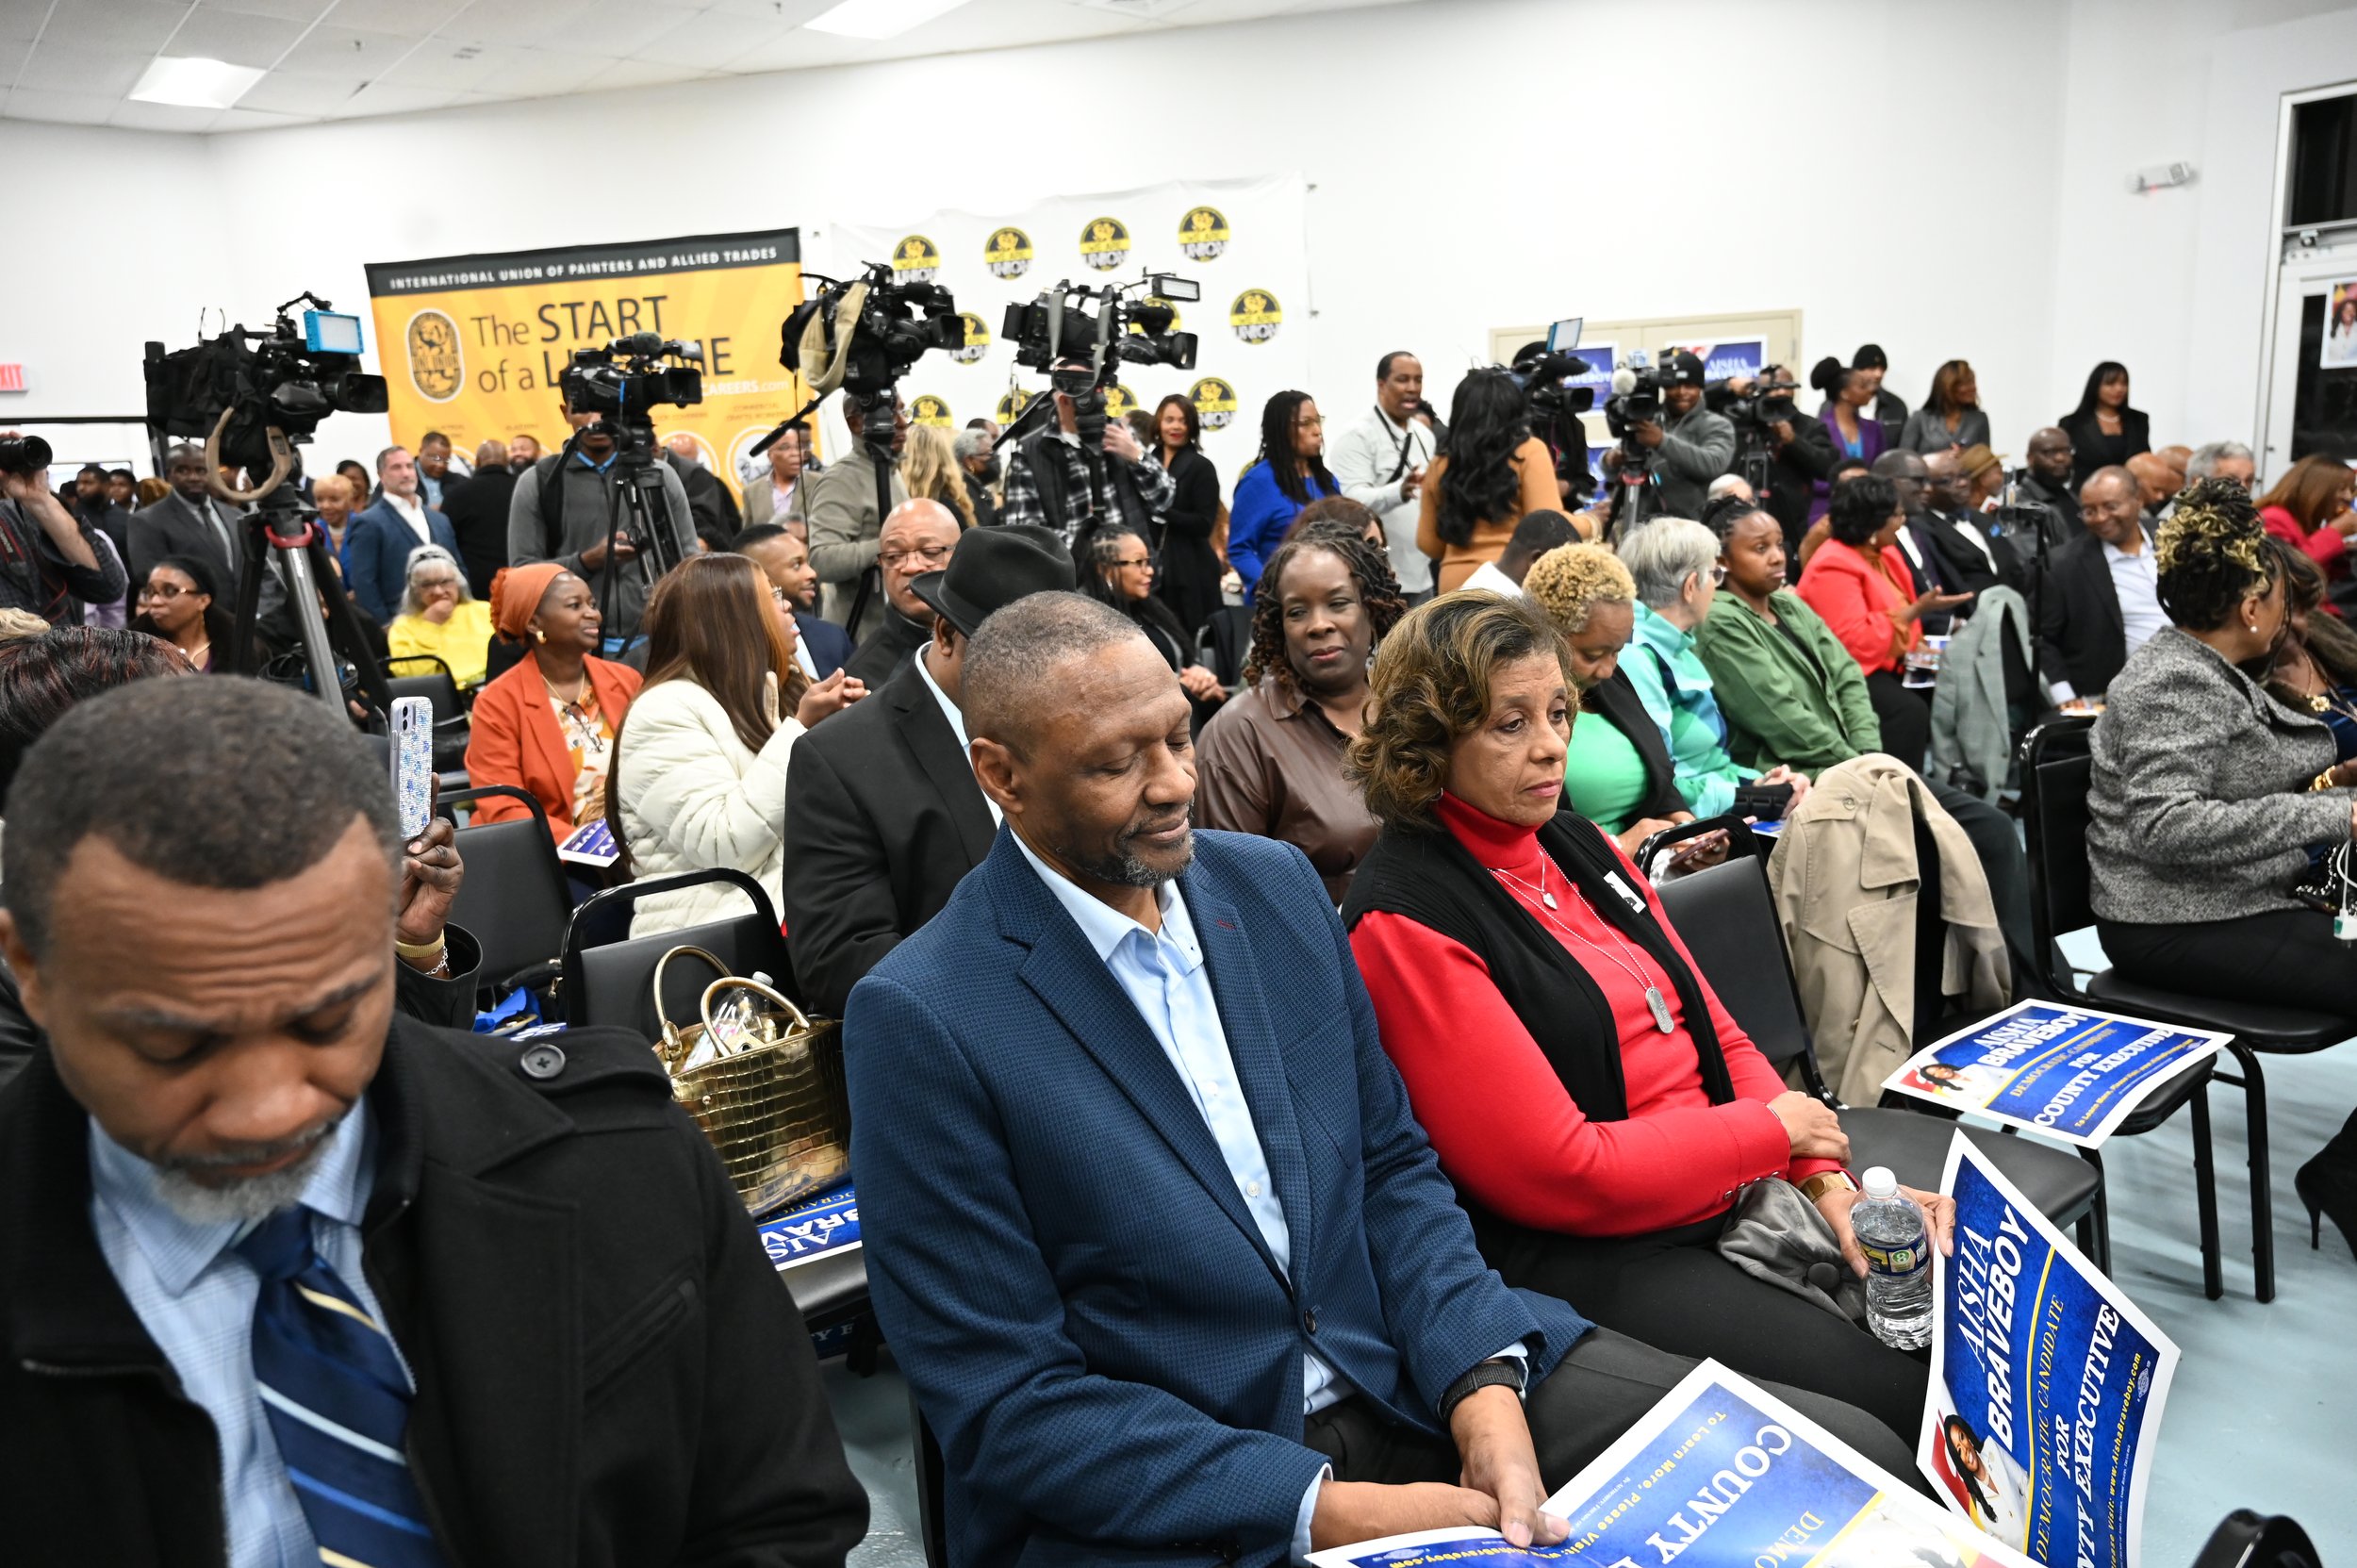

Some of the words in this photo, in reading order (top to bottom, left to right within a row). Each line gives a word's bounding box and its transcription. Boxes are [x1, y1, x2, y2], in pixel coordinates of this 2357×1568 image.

[389, 271, 495, 289] INTERNATIONAL
[499, 267, 542, 281] UNION
[546, 264, 564, 277] OF
[569, 257, 634, 276] PAINTERS
[637, 256, 667, 271] AND
[670, 251, 719, 268] ALLIED
[723, 246, 777, 263] TRADES
[470, 314, 530, 348] The
[537, 295, 668, 342] START
[478, 358, 508, 393] of
[519, 368, 536, 390] a
[1198, 411, 1232, 426] NION
[1973, 1017, 2048, 1049] AISHA
[1977, 1012, 2088, 1067] BRAVEBOY
[2068, 1051, 2102, 1069] FOR
[2034, 1070, 2101, 1127] COUNTY
[761, 1208, 859, 1246] BRAV
[765, 1228, 834, 1261] AIS
[1957, 1225, 1992, 1374] AISHA
[1986, 1203, 2029, 1454] BRAVEBOY
[2037, 1293, 2065, 1409] CANDIDATE
[1707, 1411, 1728, 1427] To
[2073, 1302, 2120, 1504] EXECUTIVE
[2109, 1351, 2141, 1497] www.AishaBraveboy.com
[1673, 1426, 1711, 1461] Learn
[2054, 1413, 2071, 1480] FOR
[1638, 1459, 1676, 1491] More,
[1645, 1424, 1792, 1565] COUNTY
[2036, 1409, 2052, 1564] DEMOCRATIC
[1597, 1492, 1641, 1532] Please
[2077, 1494, 2096, 1568] NTY
[2107, 1496, 2116, 1530] Visit:
[1755, 1510, 1825, 1568] DEMO
